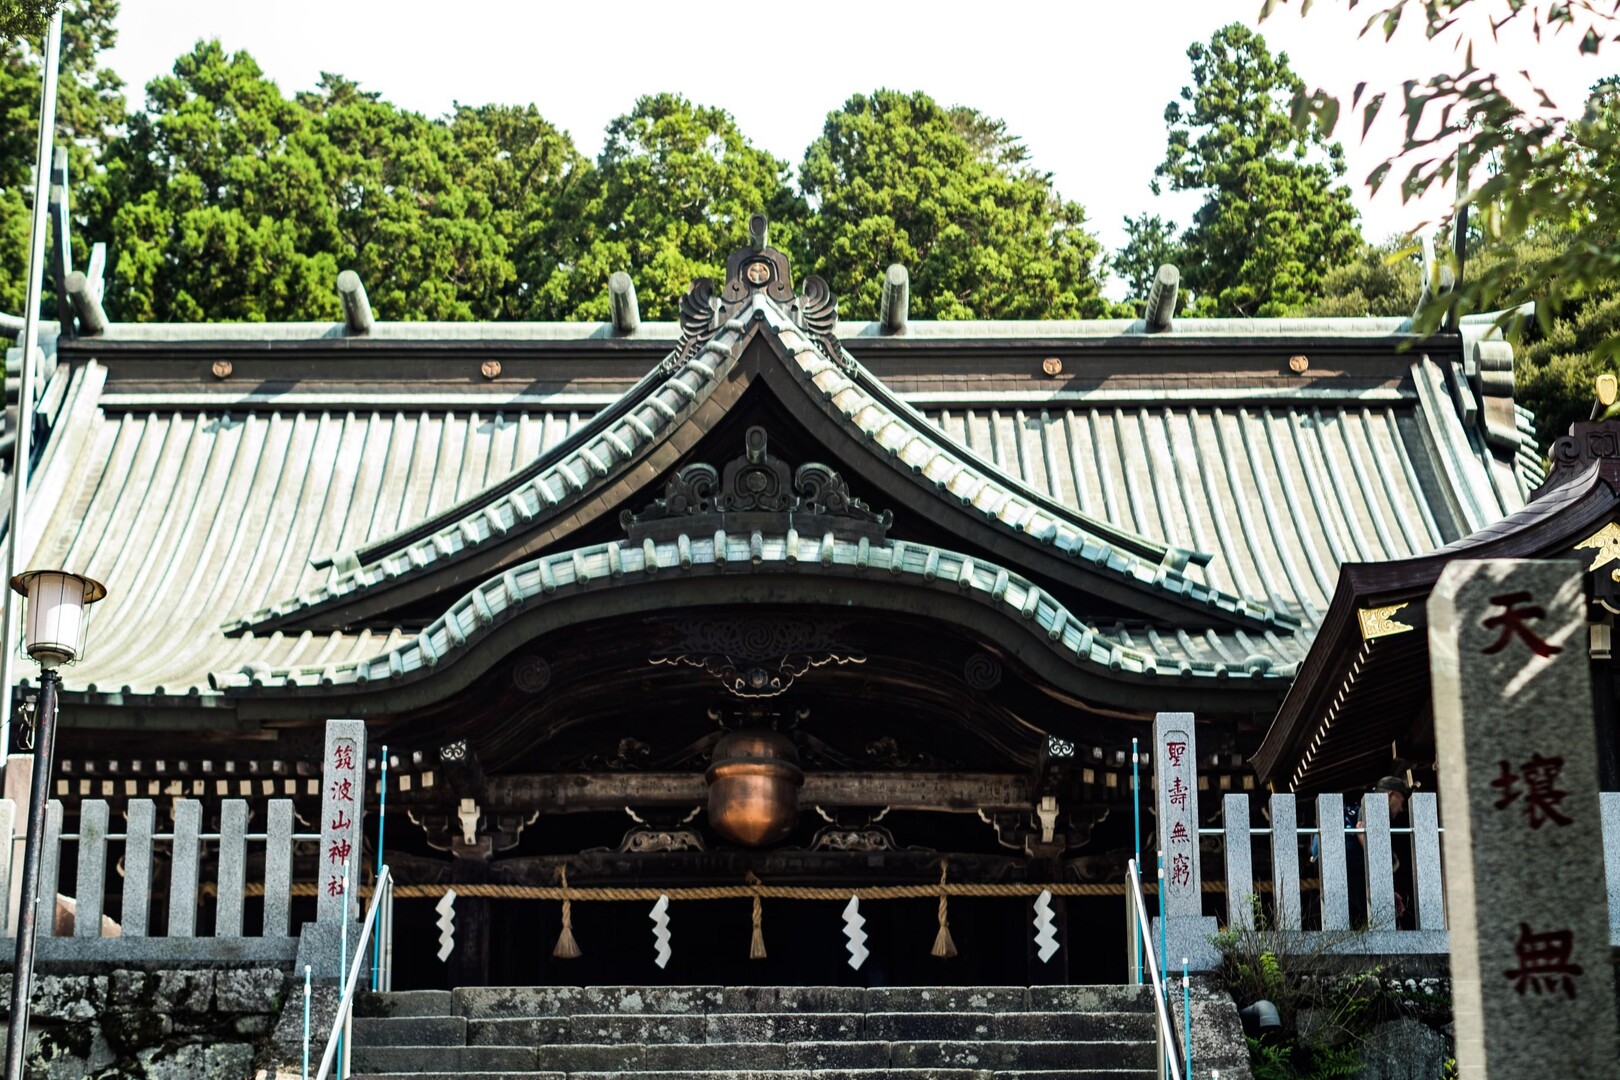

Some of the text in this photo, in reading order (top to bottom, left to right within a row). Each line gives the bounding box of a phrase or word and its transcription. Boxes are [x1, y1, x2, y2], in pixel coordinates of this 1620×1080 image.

[327, 745, 355, 897] 筑波山神社
